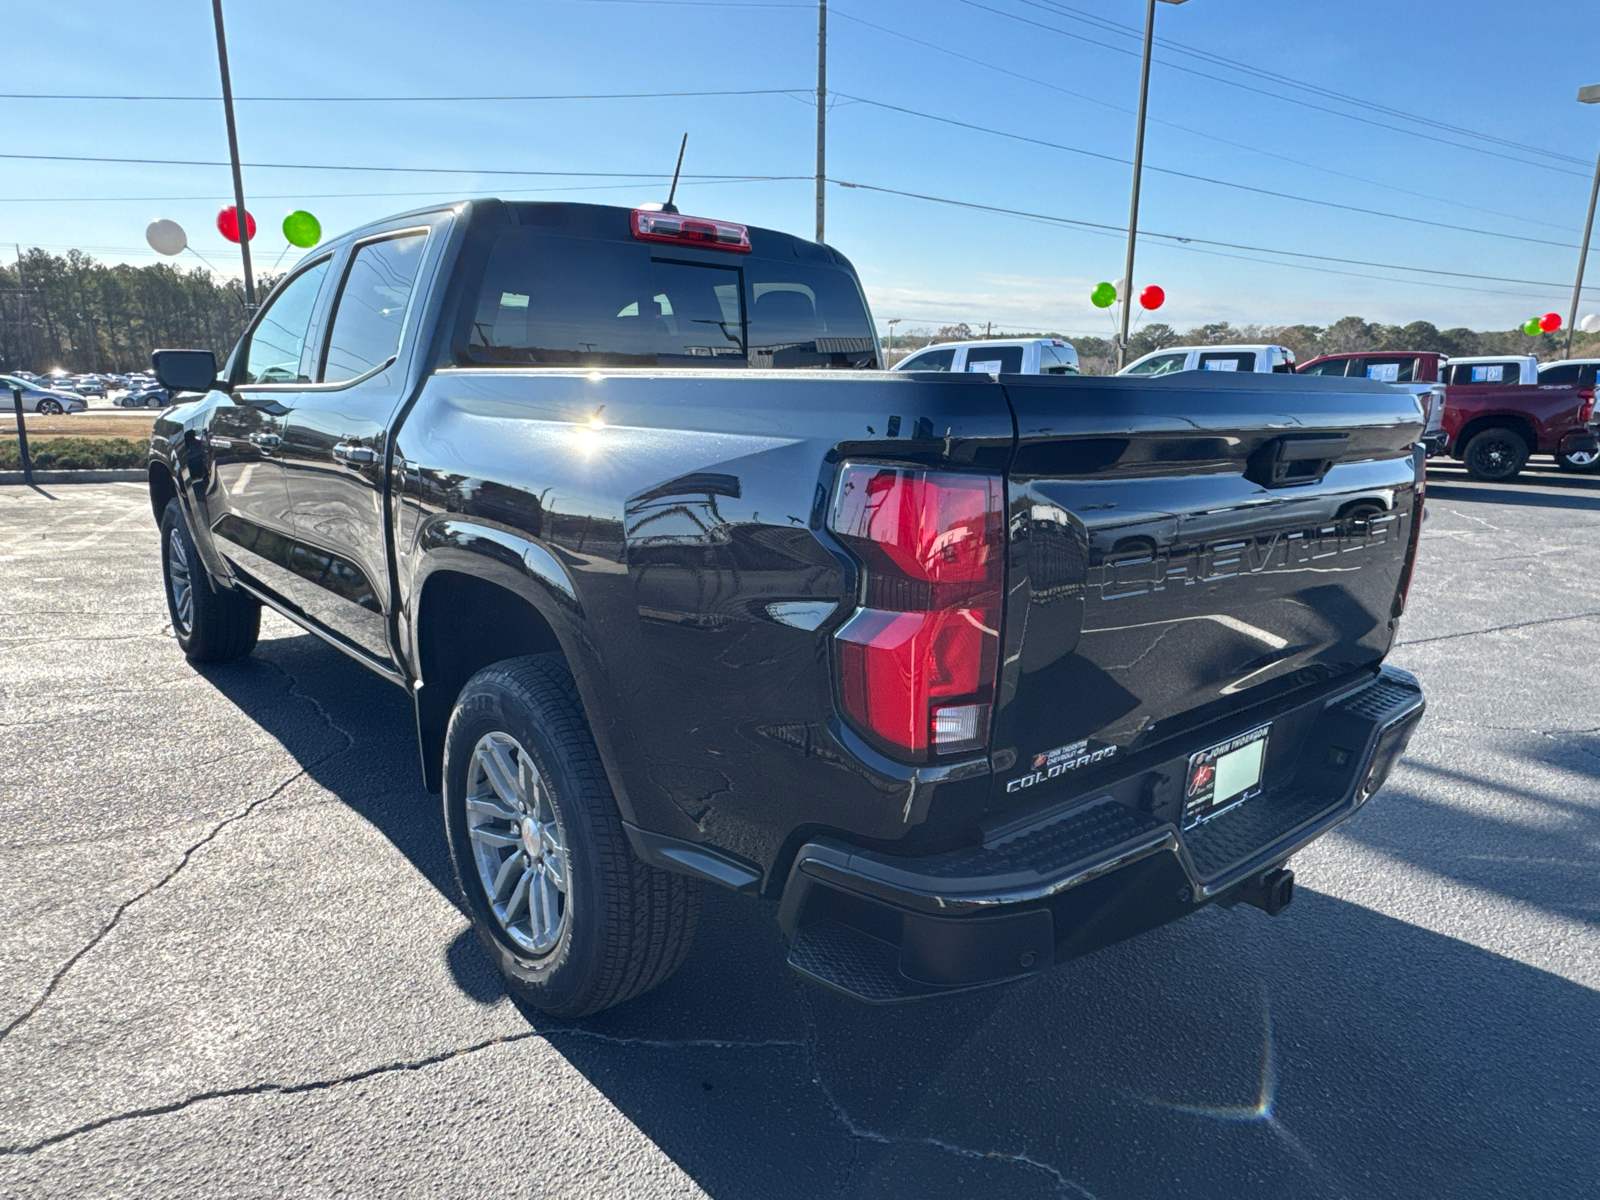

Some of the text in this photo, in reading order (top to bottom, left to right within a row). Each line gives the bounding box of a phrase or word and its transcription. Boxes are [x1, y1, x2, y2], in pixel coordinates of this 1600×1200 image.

[1101, 508, 1408, 600] CHEVROLET
[1046, 750, 1077, 766] CHEVROLET
[1048, 749, 1061, 759] JOHN
[1209, 726, 1269, 759] JOHN THORNTON
[1006, 744, 1117, 793] COLORADO
